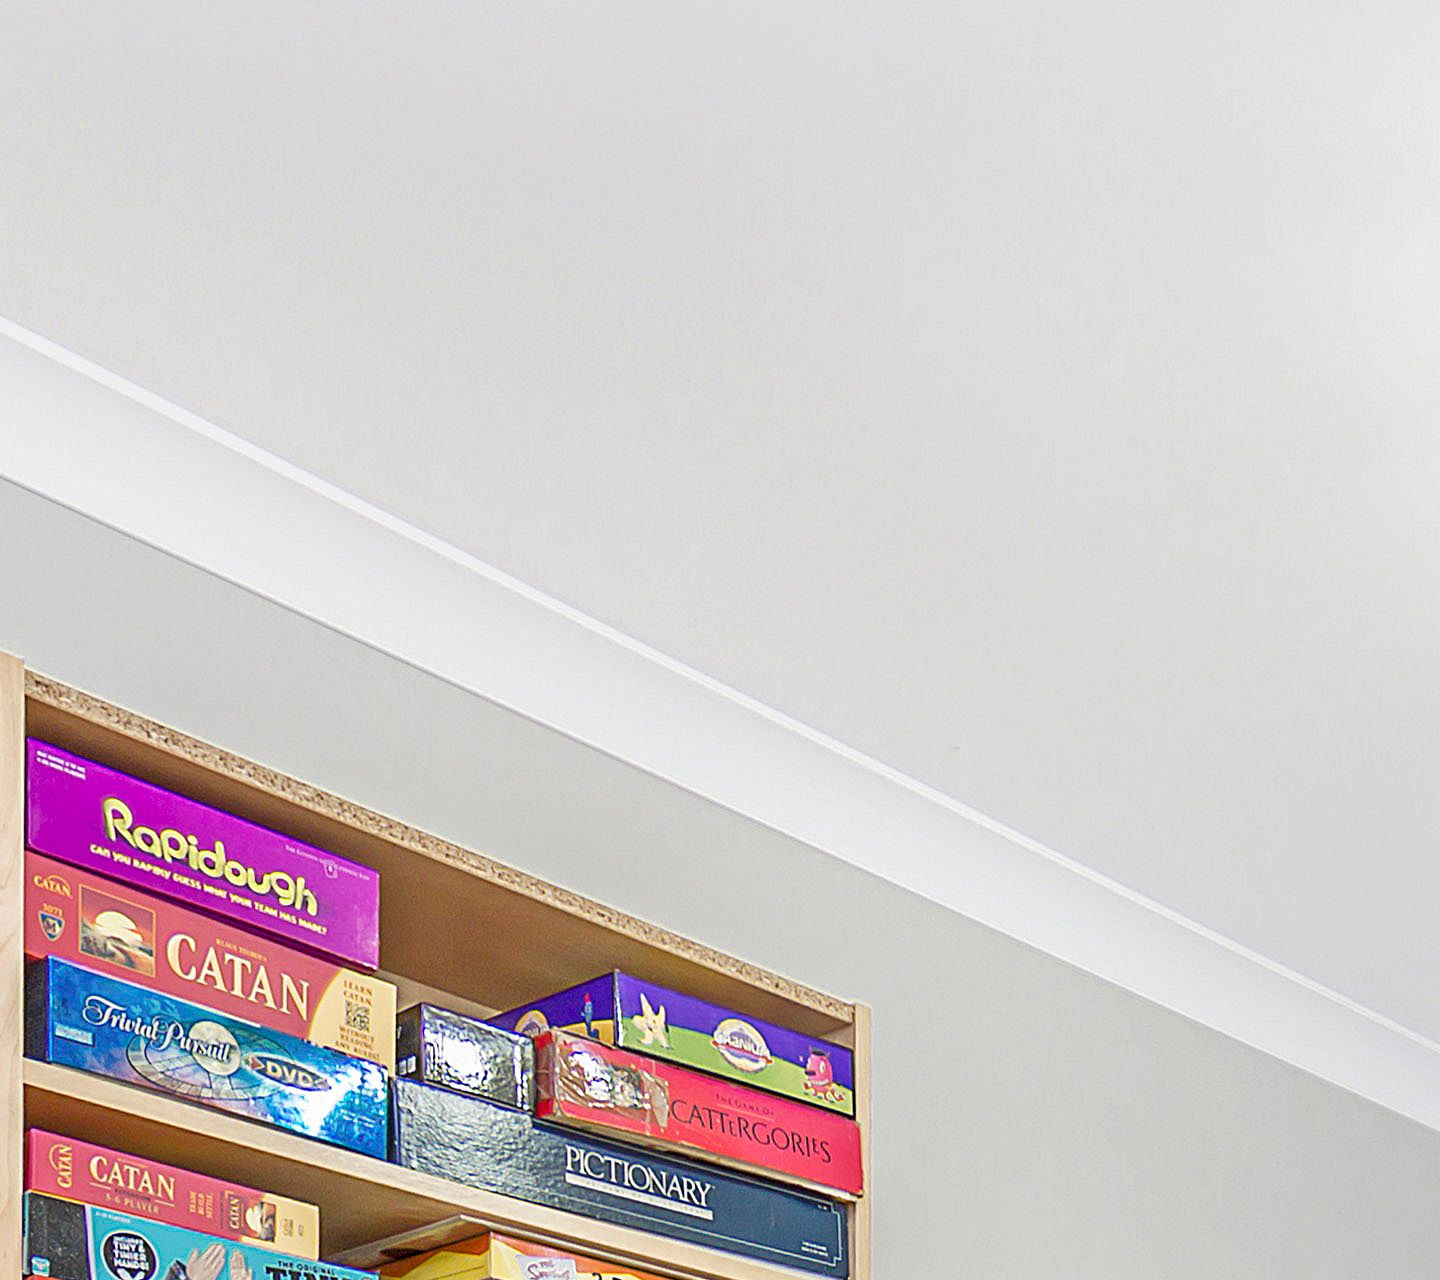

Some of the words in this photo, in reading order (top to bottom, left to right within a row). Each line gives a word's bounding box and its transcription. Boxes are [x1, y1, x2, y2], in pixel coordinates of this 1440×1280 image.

[102, 797, 319, 917] Rapidough
[166, 932, 310, 1023] CATAN
[265, 1059, 312, 1087] DVD
[89, 1155, 176, 1201] CATAN
[565, 1144, 713, 1210] PICTIONARY
